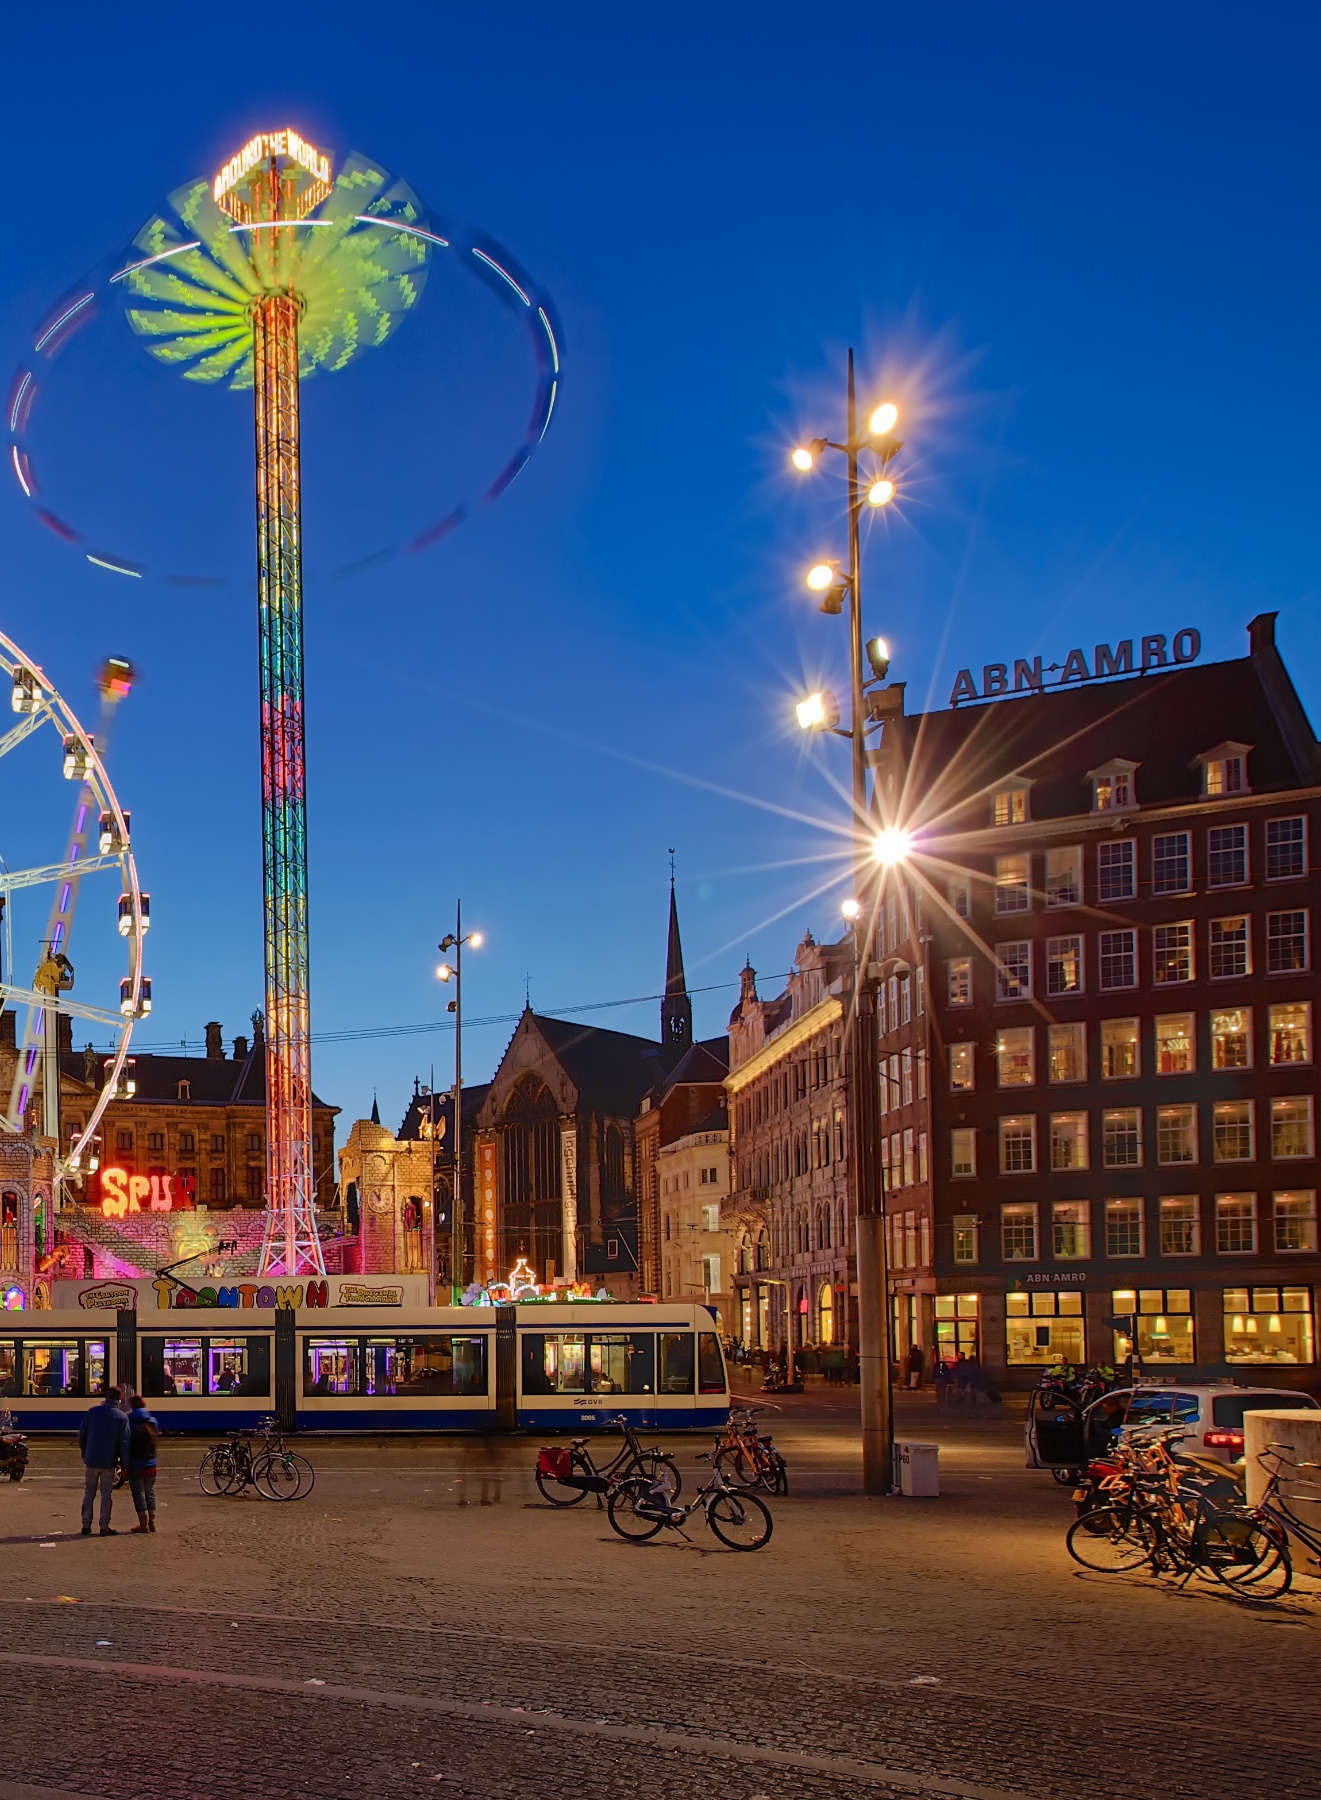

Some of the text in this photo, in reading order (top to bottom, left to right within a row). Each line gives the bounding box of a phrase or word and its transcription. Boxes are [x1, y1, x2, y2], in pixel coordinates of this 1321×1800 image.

[213, 127, 329, 202] AROUND THE WORLD
